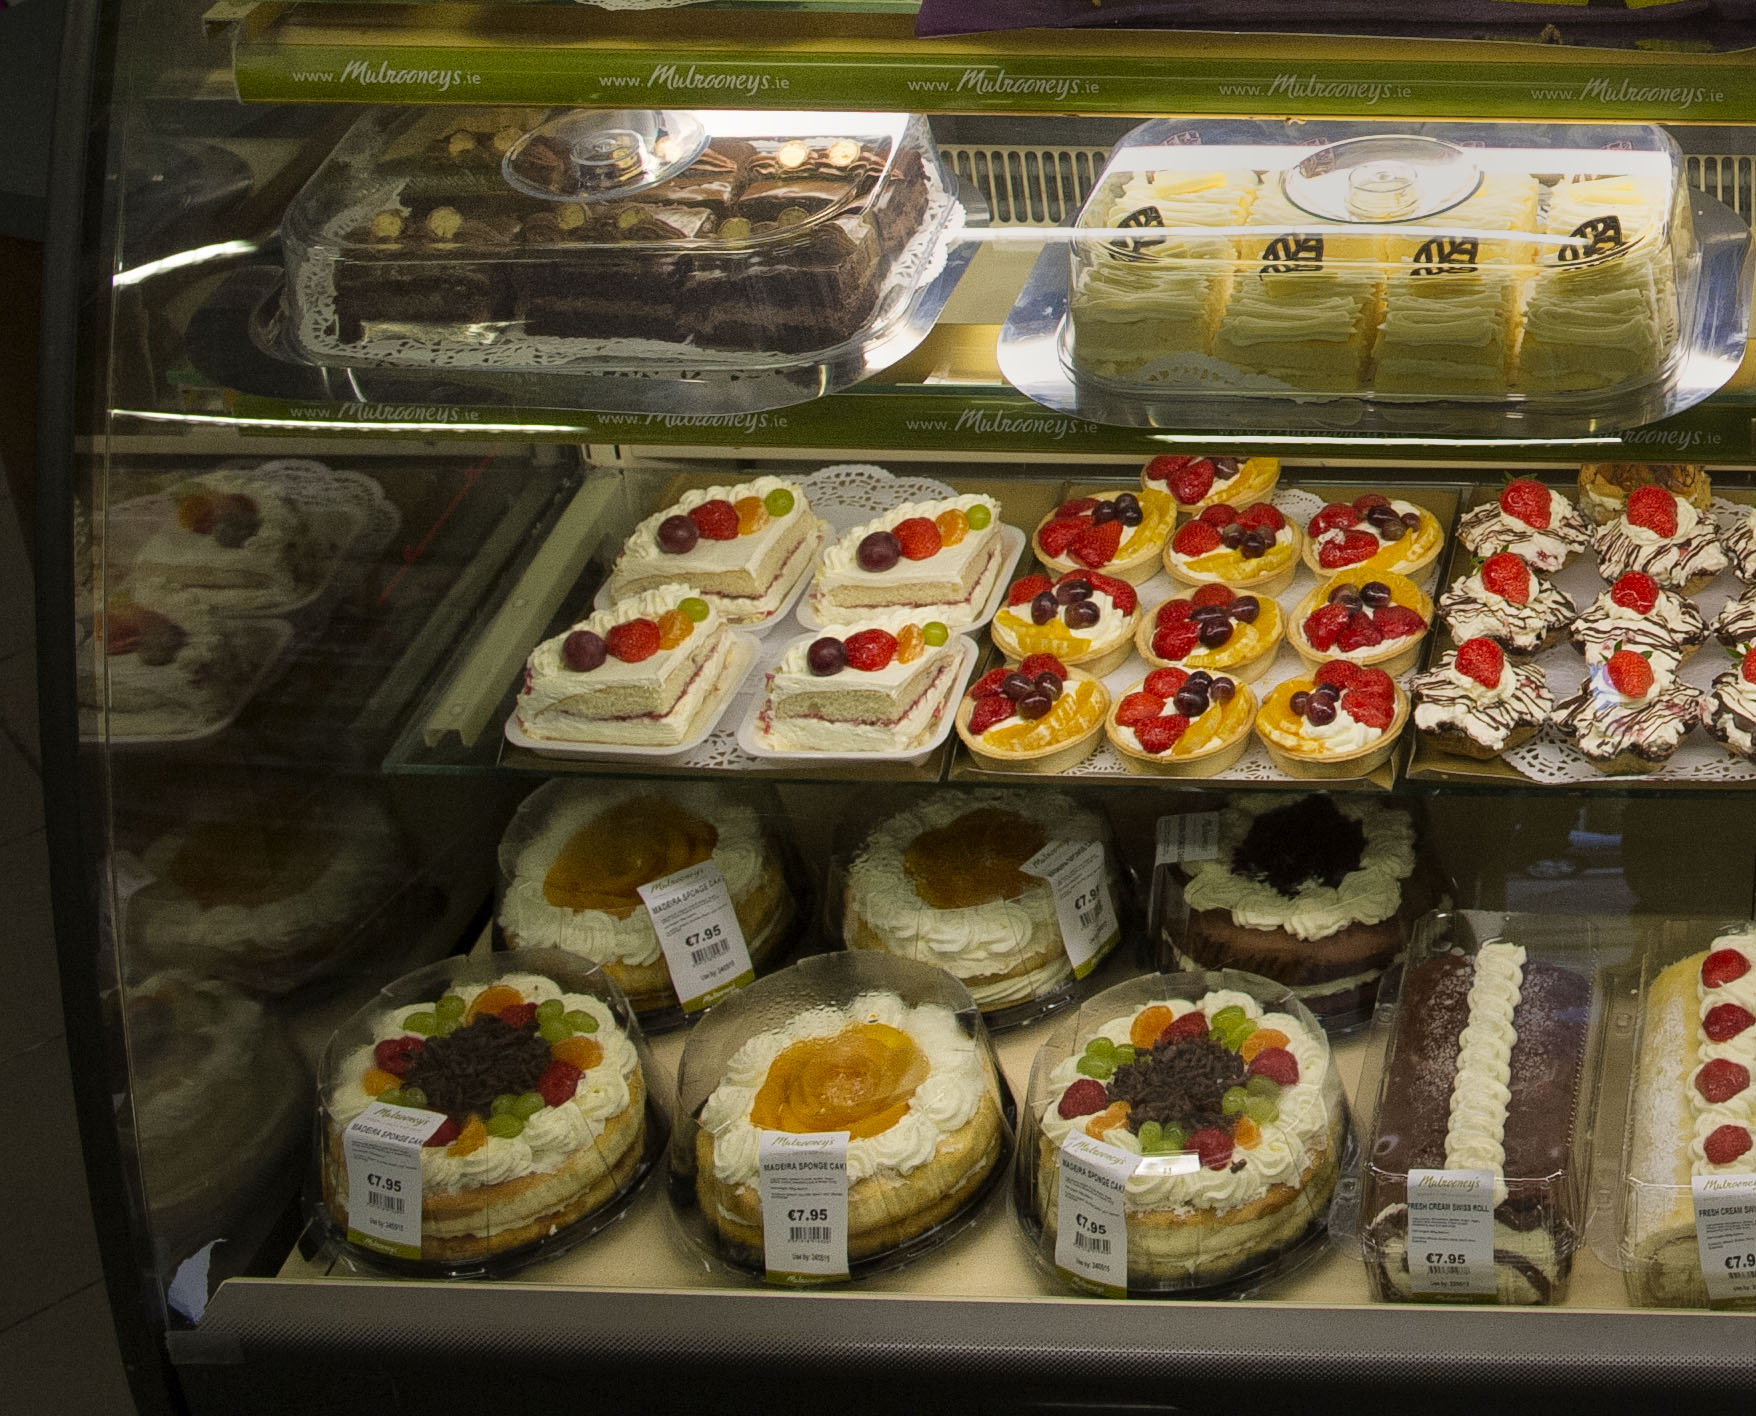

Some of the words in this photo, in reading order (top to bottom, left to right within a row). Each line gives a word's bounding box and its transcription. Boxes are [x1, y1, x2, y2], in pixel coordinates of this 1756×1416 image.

[684, 923, 722, 947] €7.95
[367, 1172, 402, 1193] €7.95
[787, 1208, 828, 1222] €7.95
[1075, 1212, 1107, 1236] €7.95
[1425, 1252, 1466, 1265] €7.95
